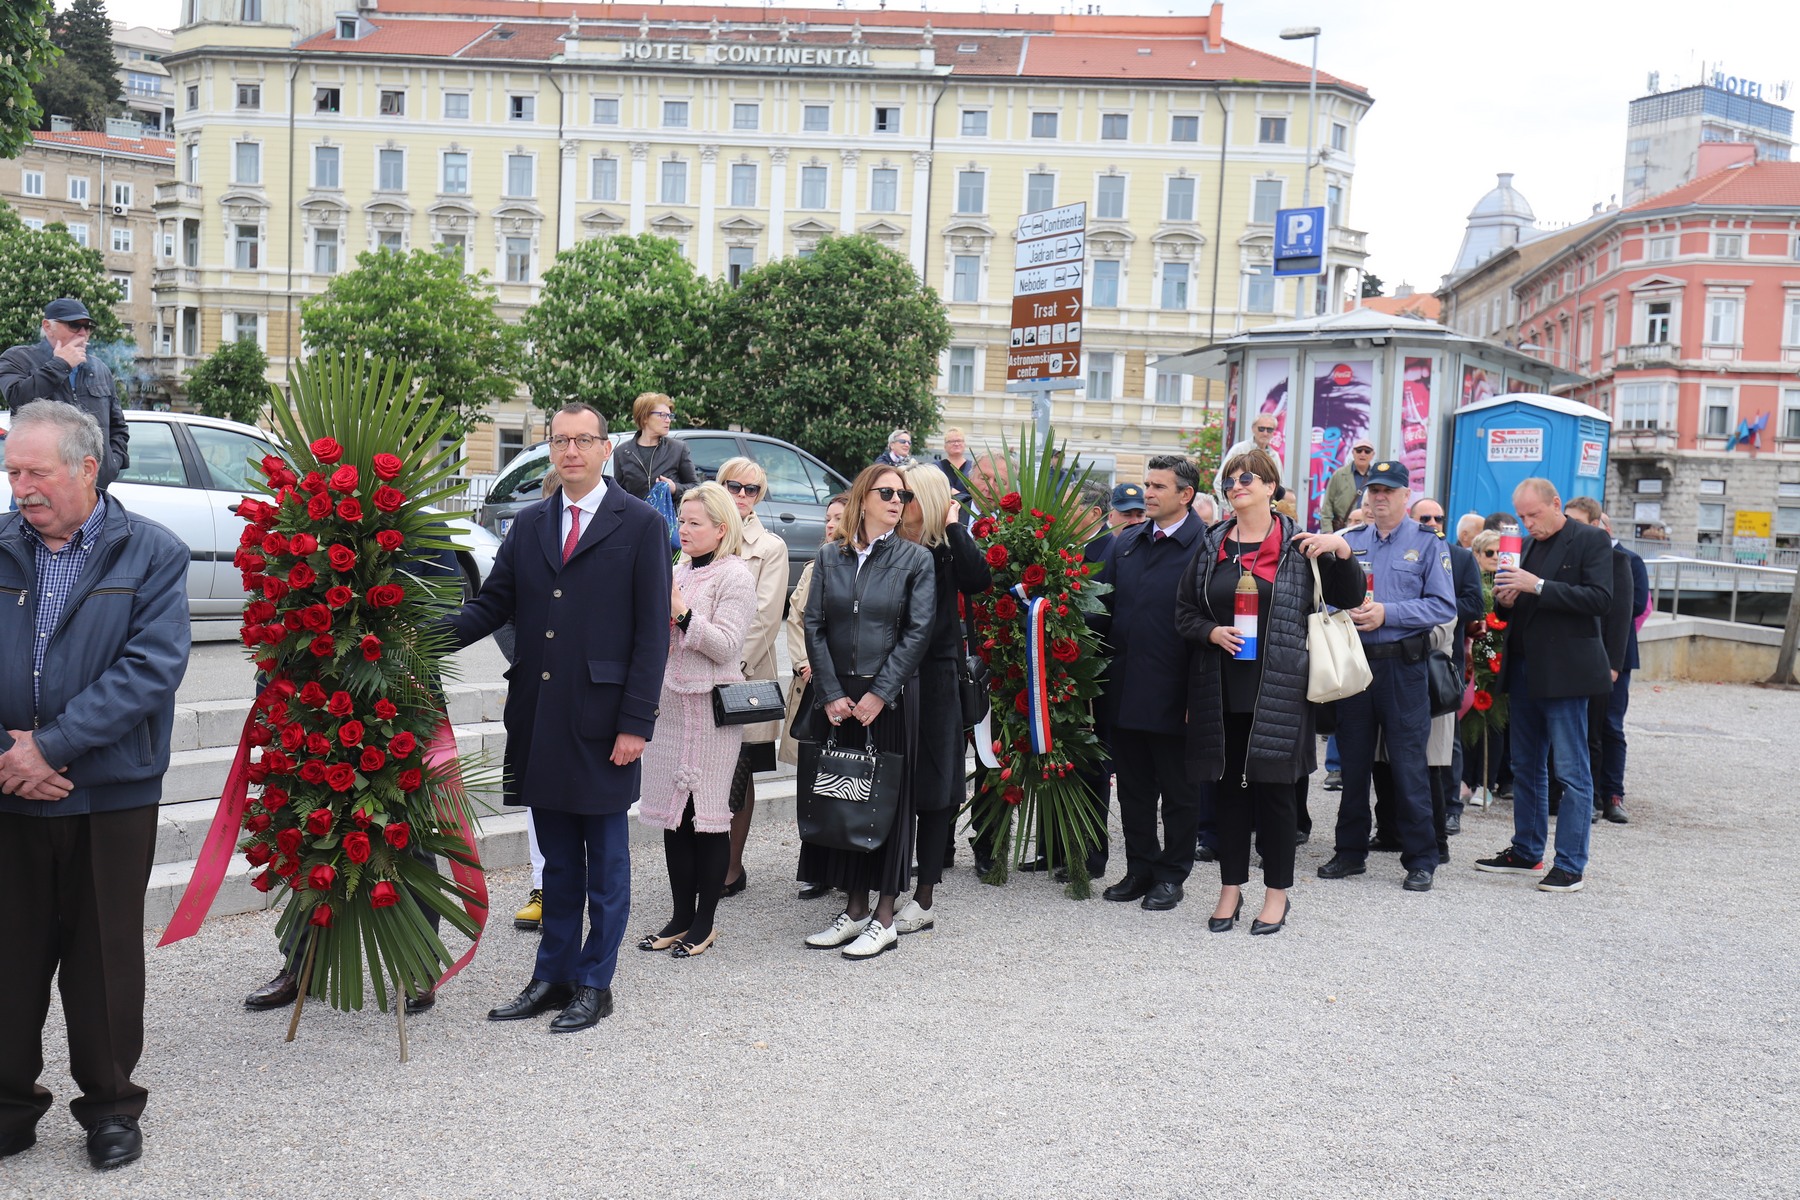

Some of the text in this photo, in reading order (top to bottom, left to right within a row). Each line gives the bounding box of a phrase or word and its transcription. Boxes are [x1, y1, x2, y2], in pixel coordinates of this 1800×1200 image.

[620, 42, 875, 66] HOTEL CONTINENTAL
[1715, 72, 1763, 101] HOTEL
[1044, 212, 1084, 233] Continental
[1288, 215, 1312, 244] P
[1029, 248, 1054, 264] Jadran
[1019, 276, 1048, 293] Neboder
[1033, 301, 1058, 319] Trsat
[1008, 351, 1050, 367] Astronomski
[1017, 366, 1039, 378] centar
[1491, 430, 1539, 444] Semmler
[1490, 446, 1539, 454] 051/277347
